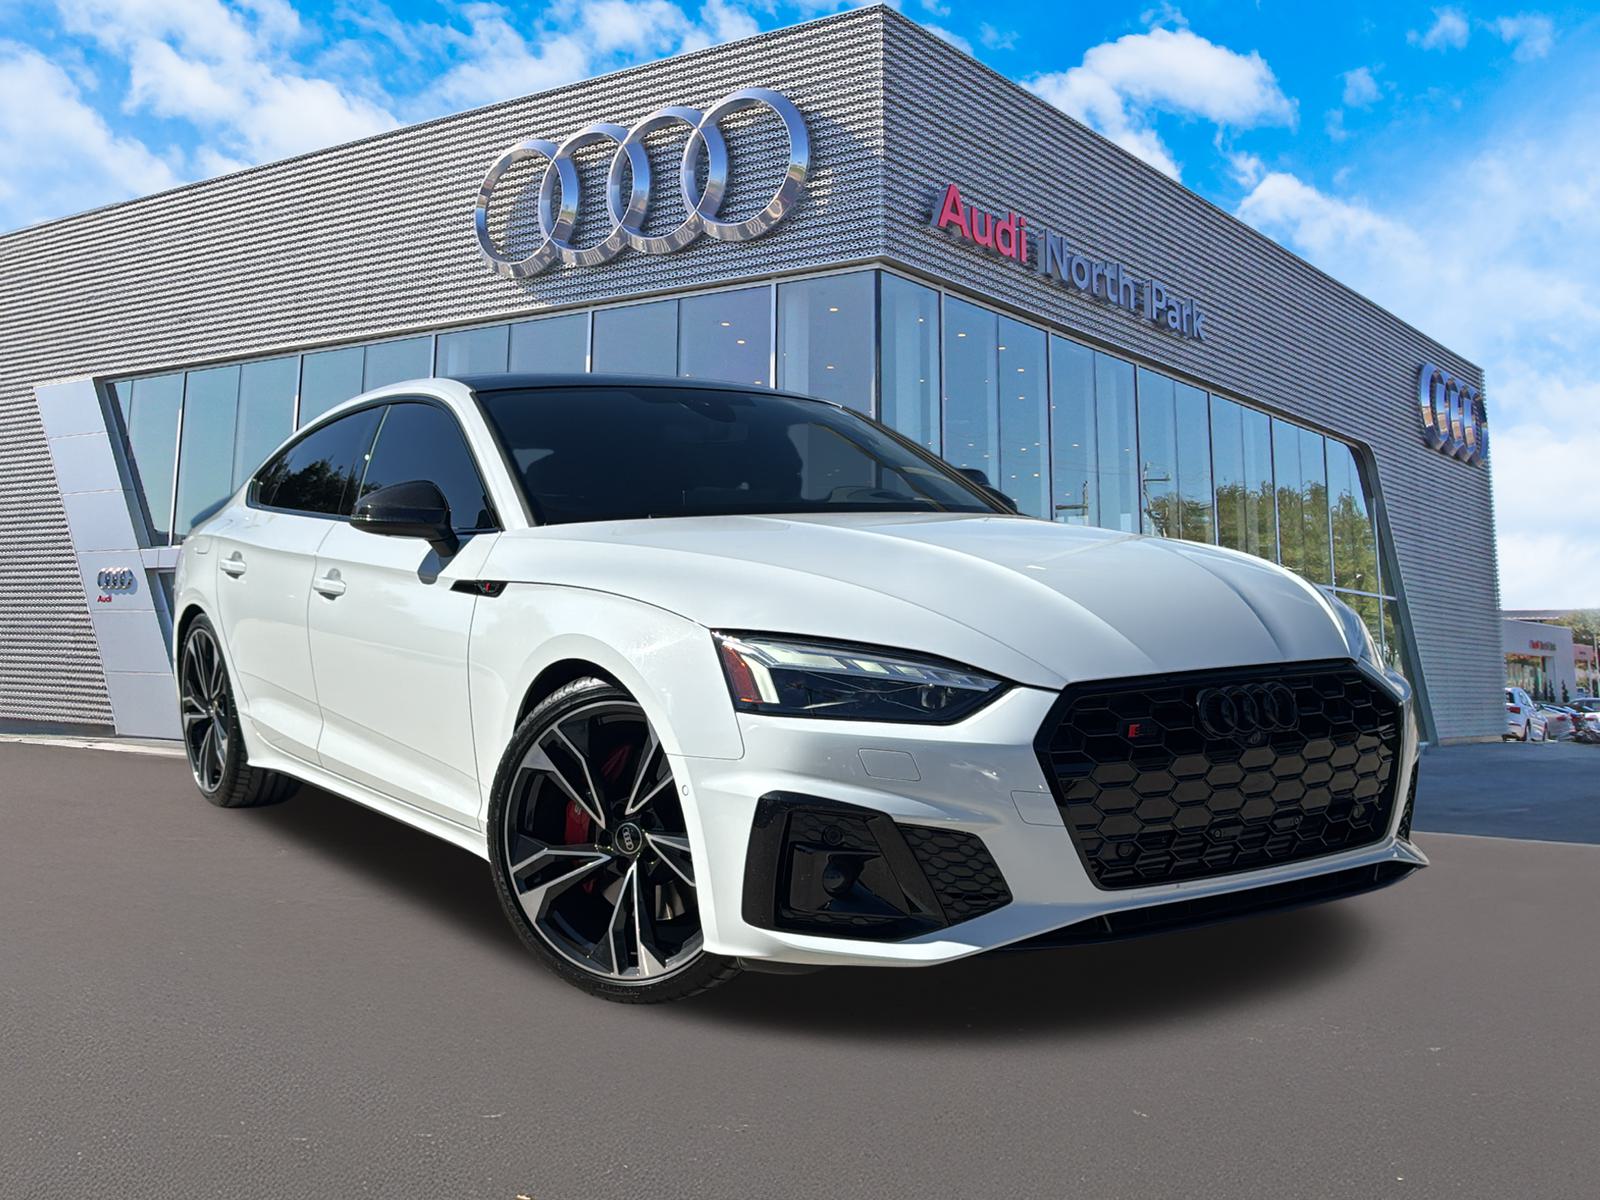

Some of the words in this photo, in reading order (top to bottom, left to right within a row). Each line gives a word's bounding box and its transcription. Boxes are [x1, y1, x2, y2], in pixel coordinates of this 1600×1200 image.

[934, 183, 1028, 264] Audi
[1038, 229, 1136, 312] North
[1143, 278, 1207, 341] Park
